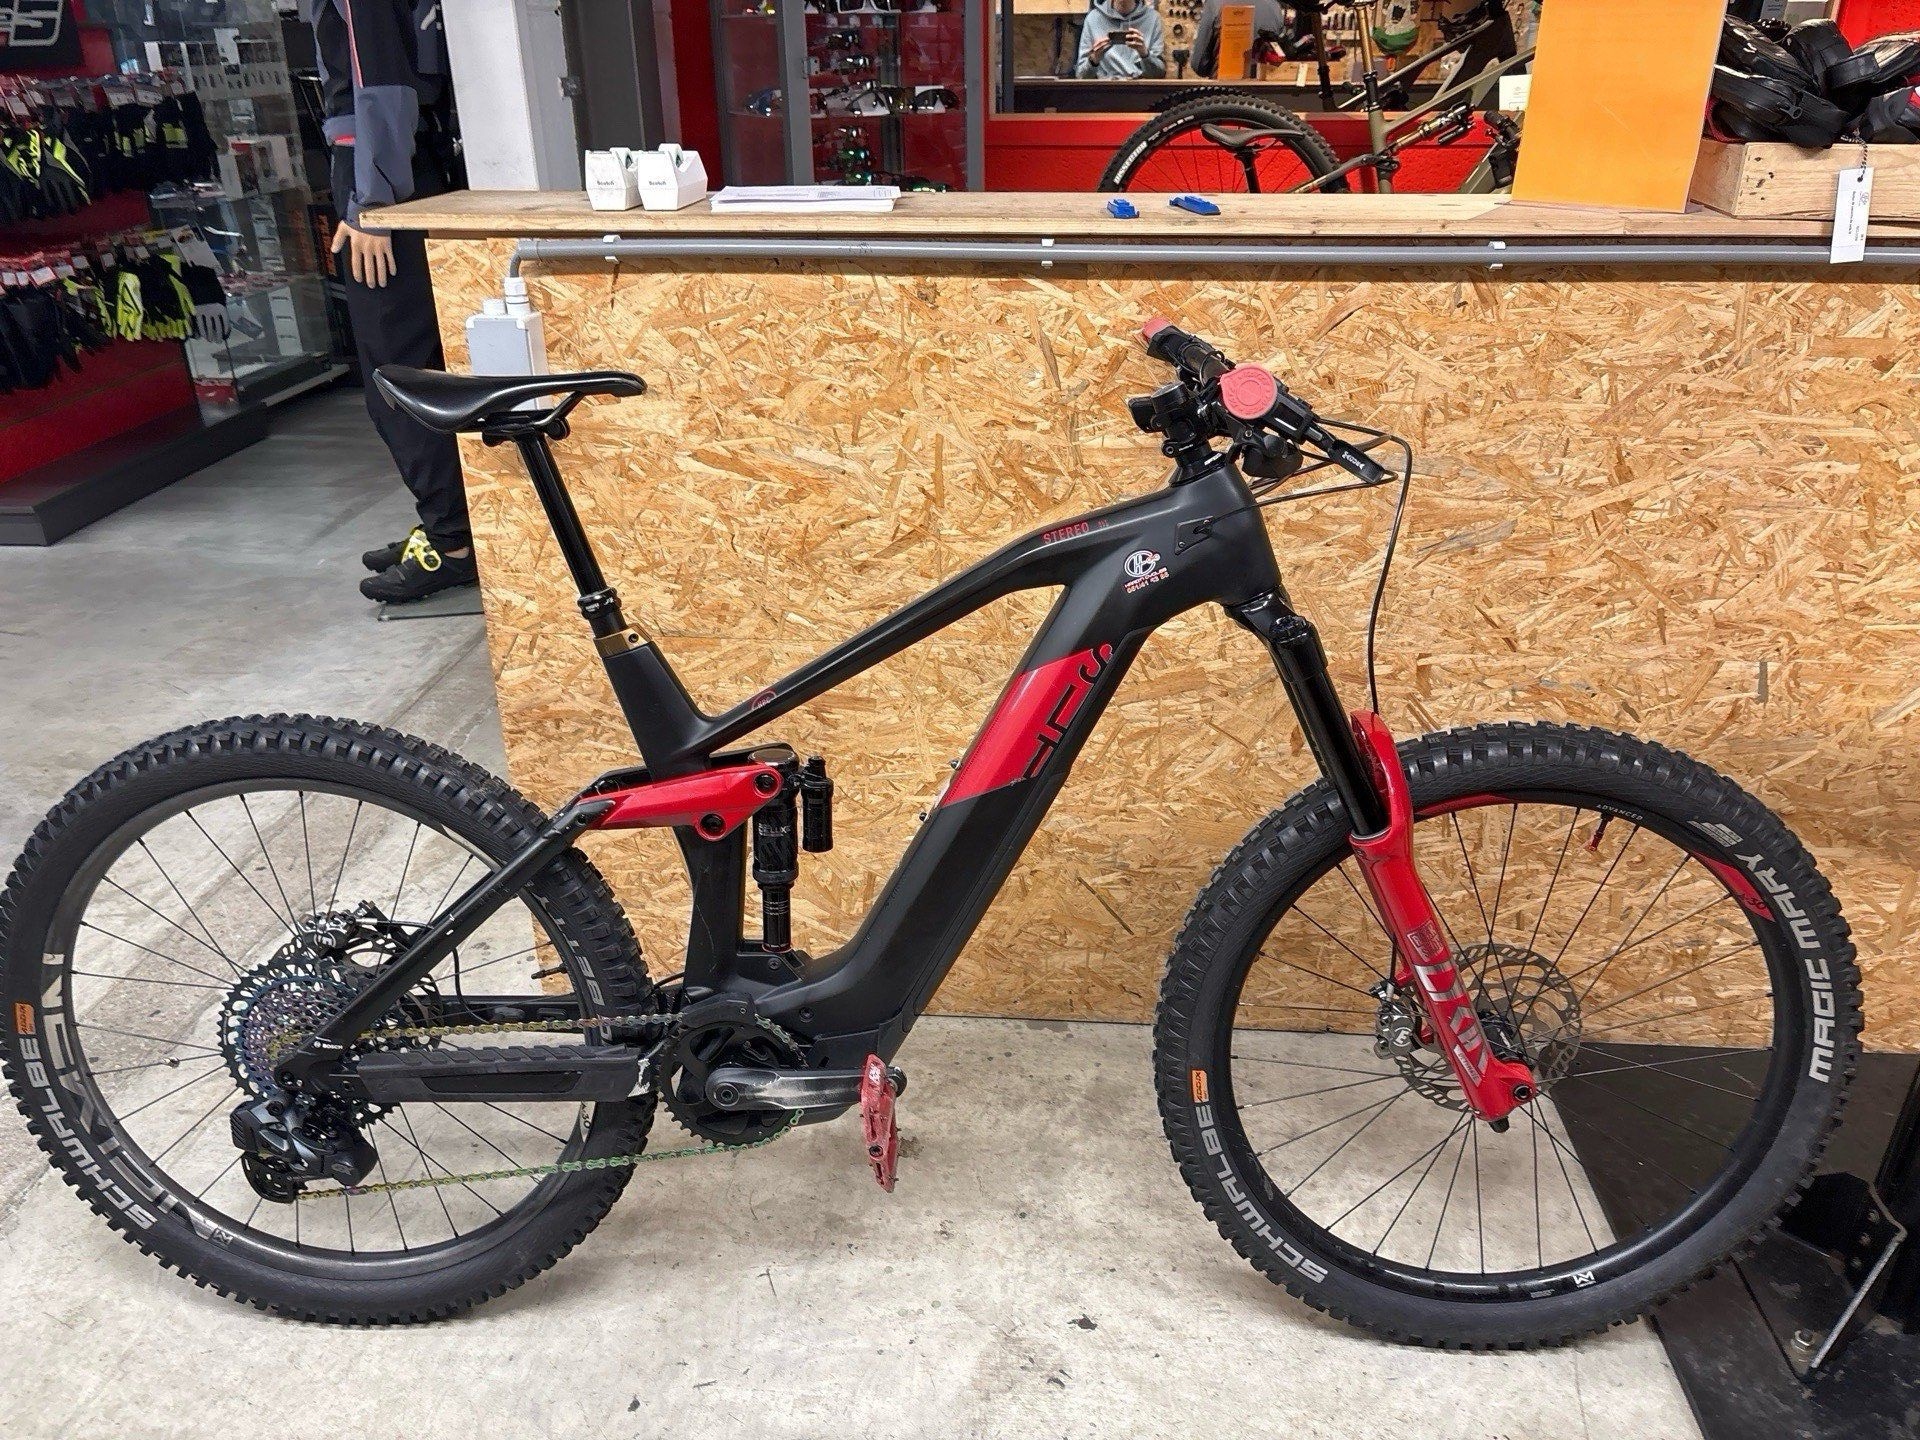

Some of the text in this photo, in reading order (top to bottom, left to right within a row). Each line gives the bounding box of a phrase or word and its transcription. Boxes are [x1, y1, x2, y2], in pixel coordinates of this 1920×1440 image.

[1043, 521, 1090, 545] STEREO
[1596, 804, 1643, 820] ADVANCED
[1734, 853, 1836, 1083] MAGIC MARY
[19, 1037, 158, 1230] SCHWALBE
[1195, 1104, 1329, 1284] SCHWALBE
